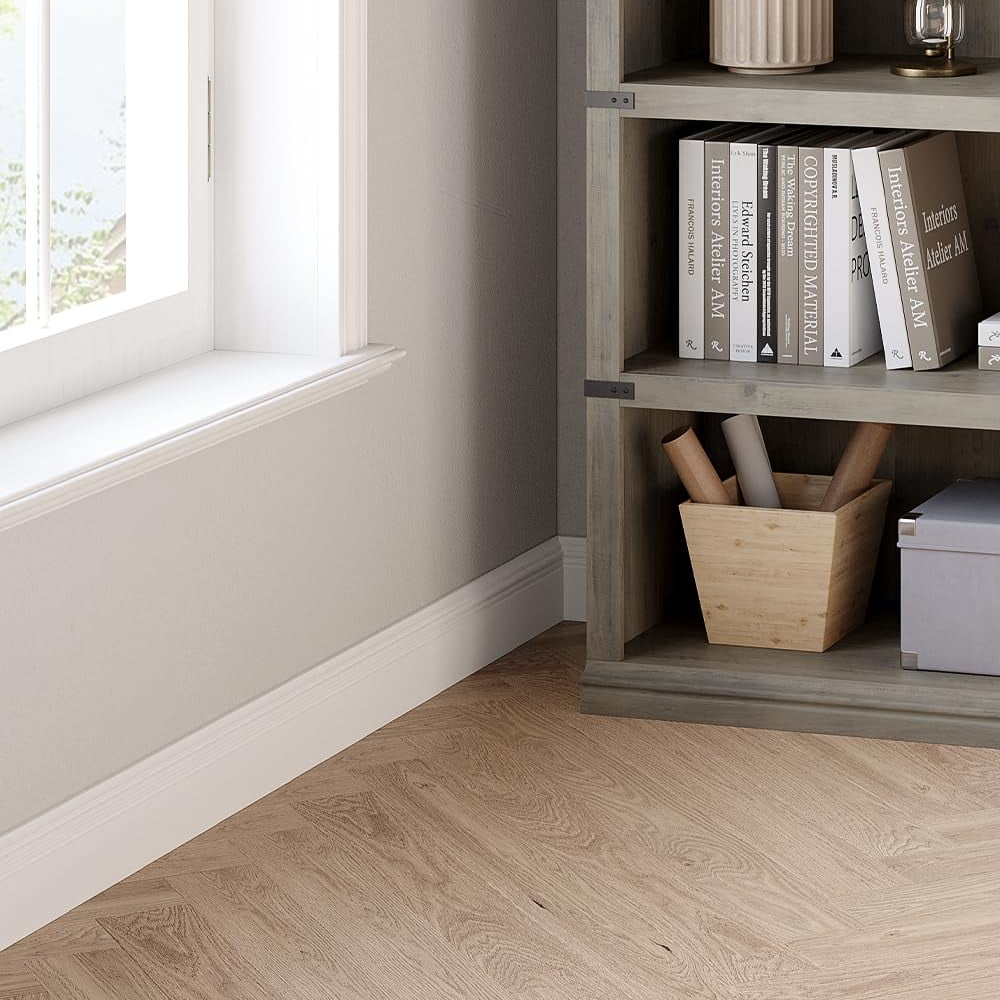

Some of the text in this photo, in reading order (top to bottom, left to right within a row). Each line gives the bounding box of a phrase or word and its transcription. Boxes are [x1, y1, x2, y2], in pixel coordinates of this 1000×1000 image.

[687, 199, 695, 276] FRANCOIS HALARD
[711, 158, 725, 319] Interiors Atelier AM
[731, 200, 739, 228] LIVES
[741, 200, 754, 302] Edward Steichen
[785, 155, 796, 257] The Waking Dream
[870, 207, 889, 285] FRANCOIS HALARD
[887, 165, 928, 329] Interiors Atelier AM
[921, 204, 958, 233] Interiors
[926, 230, 969, 271] Atelier AM
[803, 155, 818, 355] COPYRIGHTED MATERIAL
